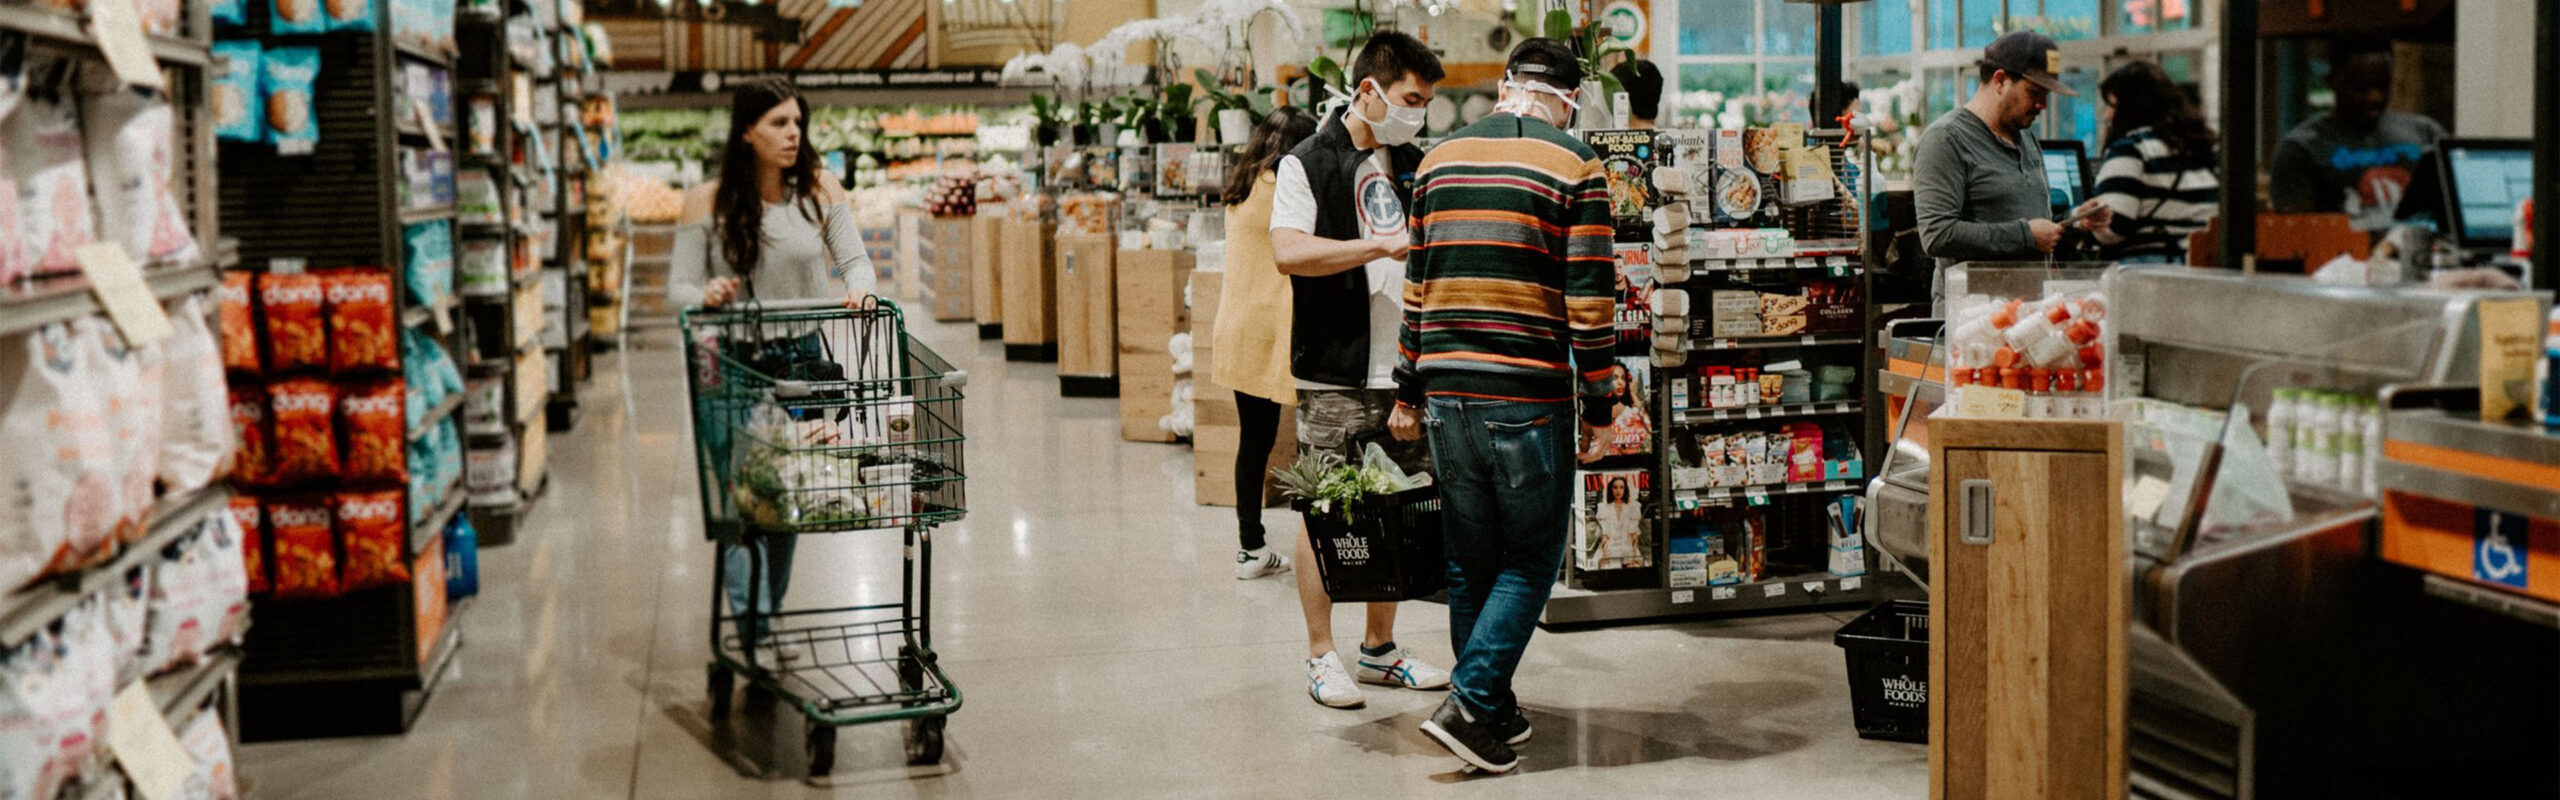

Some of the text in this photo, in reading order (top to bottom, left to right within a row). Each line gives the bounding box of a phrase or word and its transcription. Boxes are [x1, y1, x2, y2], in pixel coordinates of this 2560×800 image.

[1590, 134, 1650, 145] PLANT-BASED
[1608, 144, 1634, 153] FOOD
[262, 284, 323, 307] dang
[327, 283, 387, 306] dang
[1776, 298, 1799, 313] dang
[1820, 308, 1854, 316] COLLAGEN
[1776, 318, 1799, 333] dang
[272, 392, 331, 416] dang
[338, 394, 398, 418] dang
[270, 505, 331, 529] dang
[338, 499, 397, 522] dang
[1332, 536, 1368, 549] WHOLE
[1337, 548, 1370, 560] FOODS
[1881, 677, 1927, 693] WHOLE
[1884, 689, 1927, 703] FOODS
[1889, 701, 1920, 709] MARKET
